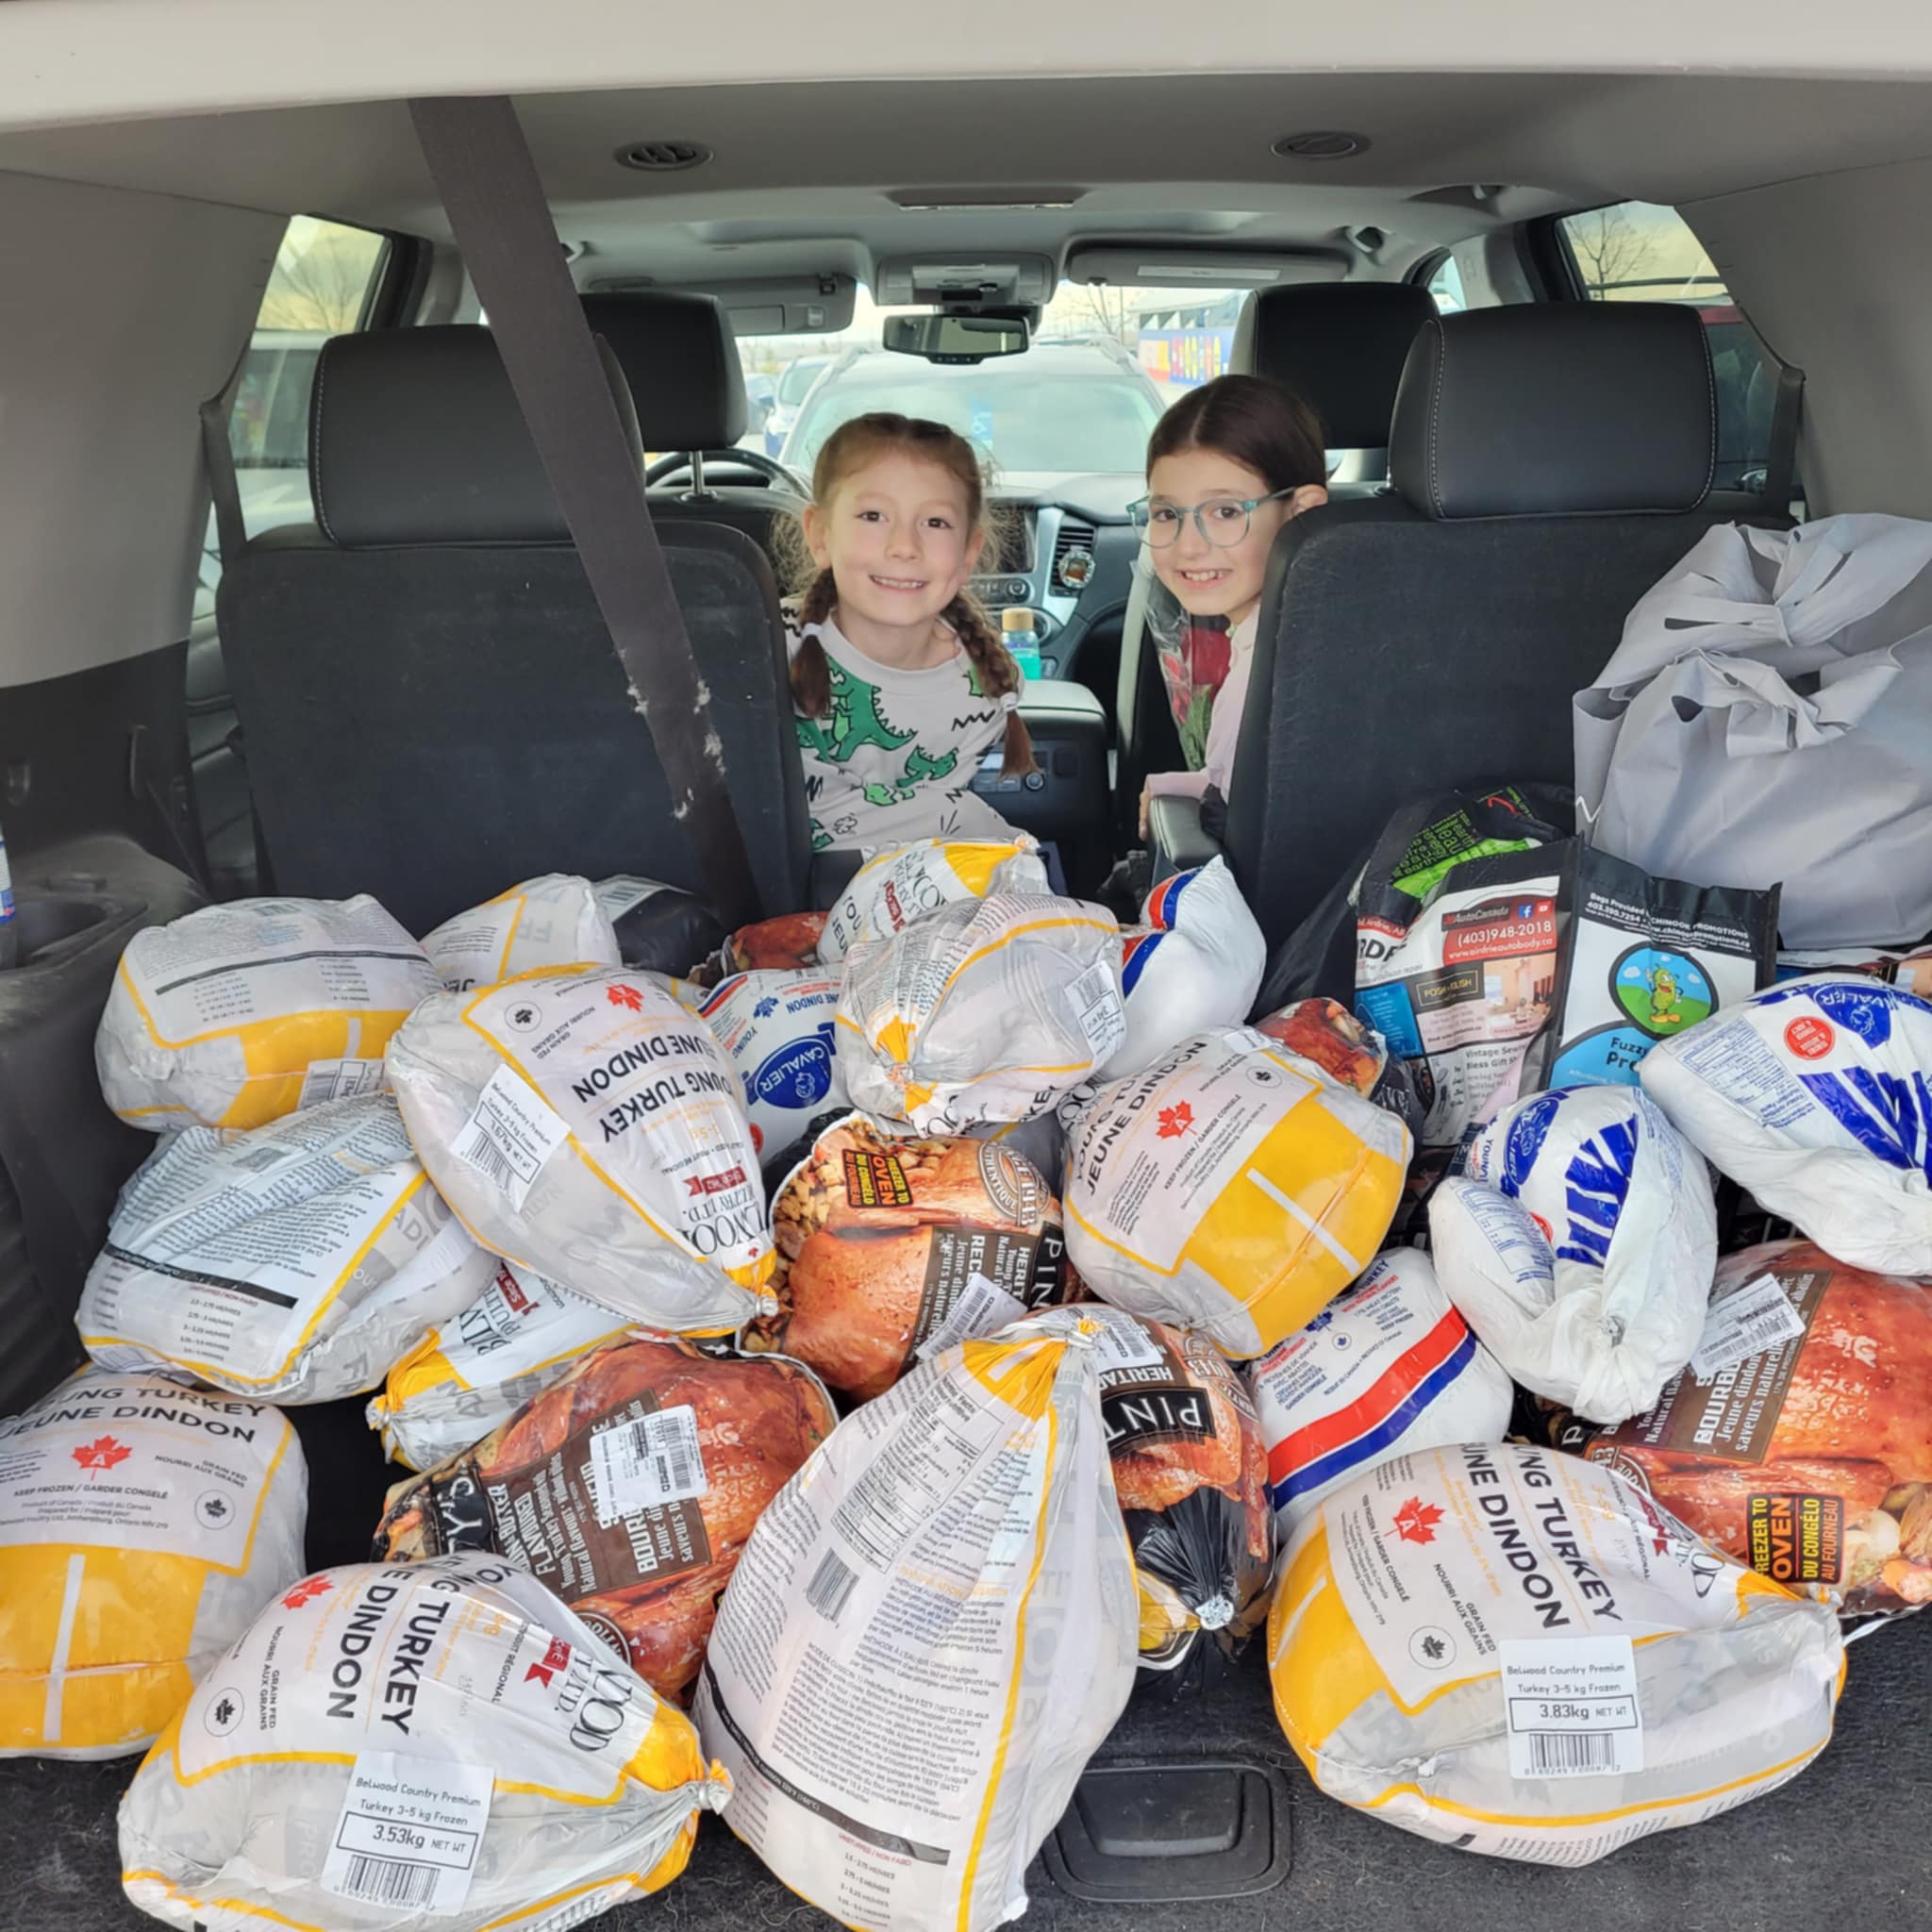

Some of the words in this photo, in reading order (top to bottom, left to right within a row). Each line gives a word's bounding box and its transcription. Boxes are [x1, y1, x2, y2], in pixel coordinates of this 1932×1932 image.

[1609, 898, 1645, 914] Provided
[1457, 917, 1553, 948] (403)948-2018
[567, 1005, 596, 1024] NOURRI
[786, 992, 826, 1015] DINDON
[527, 1031, 558, 1053] GRAINS
[547, 1030, 573, 1052] GRAIN
[553, 1021, 571, 1035] AUX
[535, 1045, 552, 1059] FED
[572, 1037, 671, 1103] DINDON
[758, 1044, 827, 1092] CAVALIER
[1465, 1046, 1499, 1059] Vintage
[599, 1073, 684, 1143] TURKEY
[1089, 1112, 1132, 1195] JEUNE
[1134, 1041, 1208, 1111] DINDON
[1174, 1145, 1198, 1174] FROZEN
[873, 1154, 895, 1206] OVEN
[896, 1191, 909, 1204] TO
[953, 1239, 968, 1274] Jeune
[993, 1236, 1008, 1276] Natural
[1002, 1249, 1016, 1280] Young
[1011, 1246, 1030, 1300] HERIT
[136, 1387, 269, 1418] TURKEY
[1716, 1397, 1745, 1442] Jeune
[1733, 1352, 1762, 1399] dindon
[112, 1406, 256, 1443] DINDON
[1644, 1395, 1674, 1444] Natural
[1733, 1397, 1766, 1453] saveurs
[36, 1479, 75, 1498] FROZEN
[83, 1481, 123, 1497] GARDER
[154, 1454, 192, 1468] NOURRI
[192, 1464, 214, 1474] AUX
[212, 1471, 246, 1488] GRAINS
[201, 1459, 230, 1474] GRAIN
[231, 1472, 248, 1481] FED
[487, 1481, 519, 1539] BUTTER
[1752, 1497, 1767, 1515] TO
[511, 1489, 557, 1576] FLAVOURED
[543, 1516, 568, 1554] Turkey
[559, 1506, 587, 1551] flavours
[651, 1522, 675, 1562] Jeune
[670, 1513, 694, 1562] saveurs
[1750, 1517, 1771, 1572] REEZER
[1767, 1497, 1795, 1578] OVEN
[1797, 1498, 1821, 1557] CONGÉLO
[1820, 1499, 1839, 1561] FOURNEAU
[553, 1552, 578, 1588] Young
[572, 1549, 597, 1591] Natural
[1371, 1534, 1392, 1565] GARDER
[1384, 1563, 1410, 1603] CONGELÉ
[1476, 1486, 1571, 1636] DINDON
[1532, 1491, 1624, 1634] TURKEY
[1803, 1560, 1818, 1577] DU
[1821, 1564, 1835, 1579] AU
[1374, 1576, 1391, 1600] Canada
[1432, 1561, 1457, 1600] NOURRI
[1452, 1597, 1468, 1620] AUX
[1463, 1618, 1487, 1657] GRAINS
[1464, 1600, 1487, 1634] GRAIN
[1481, 1632, 1496, 1653] FED
[263, 1624, 283, 1664] NOURRI
[322, 1577, 399, 1724] DINDON
[258, 1663, 273, 1685] AUX
[375, 1591, 450, 1737] TURKEY
[1507, 1663, 1545, 1675] Belwood
[1549, 1664, 1586, 1676] Country
[1589, 1662, 1624, 1674] Premium
[263, 1668, 284, 1705] GRAIN
[1517, 1681, 1549, 1696] Turkey
[1553, 1683, 1571, 1693] 3-5
[1574, 1683, 1586, 1694] kg
[1588, 1682, 1621, 1692] Frozen
[250, 1688, 275, 1731] GRAINS
[264, 1707, 279, 1729] FED
[1540, 1702, 1589, 1722] 3.83kg
[1595, 1707, 1612, 1717] NET
[1616, 1706, 1625, 1715] WT
[355, 1774, 398, 1794] Belwood
[399, 1782, 439, 1801] Country
[441, 1790, 481, 1808] Premium
[359, 1798, 394, 1815] Turkey
[396, 1803, 416, 1818] 3-5
[418, 1808, 431, 1822] kg
[433, 1810, 468, 1827] Frozen
[372, 1822, 425, 1850] 3.53kg
[430, 1838, 449, 1851] NET
[452, 1841, 466, 1853] WT
